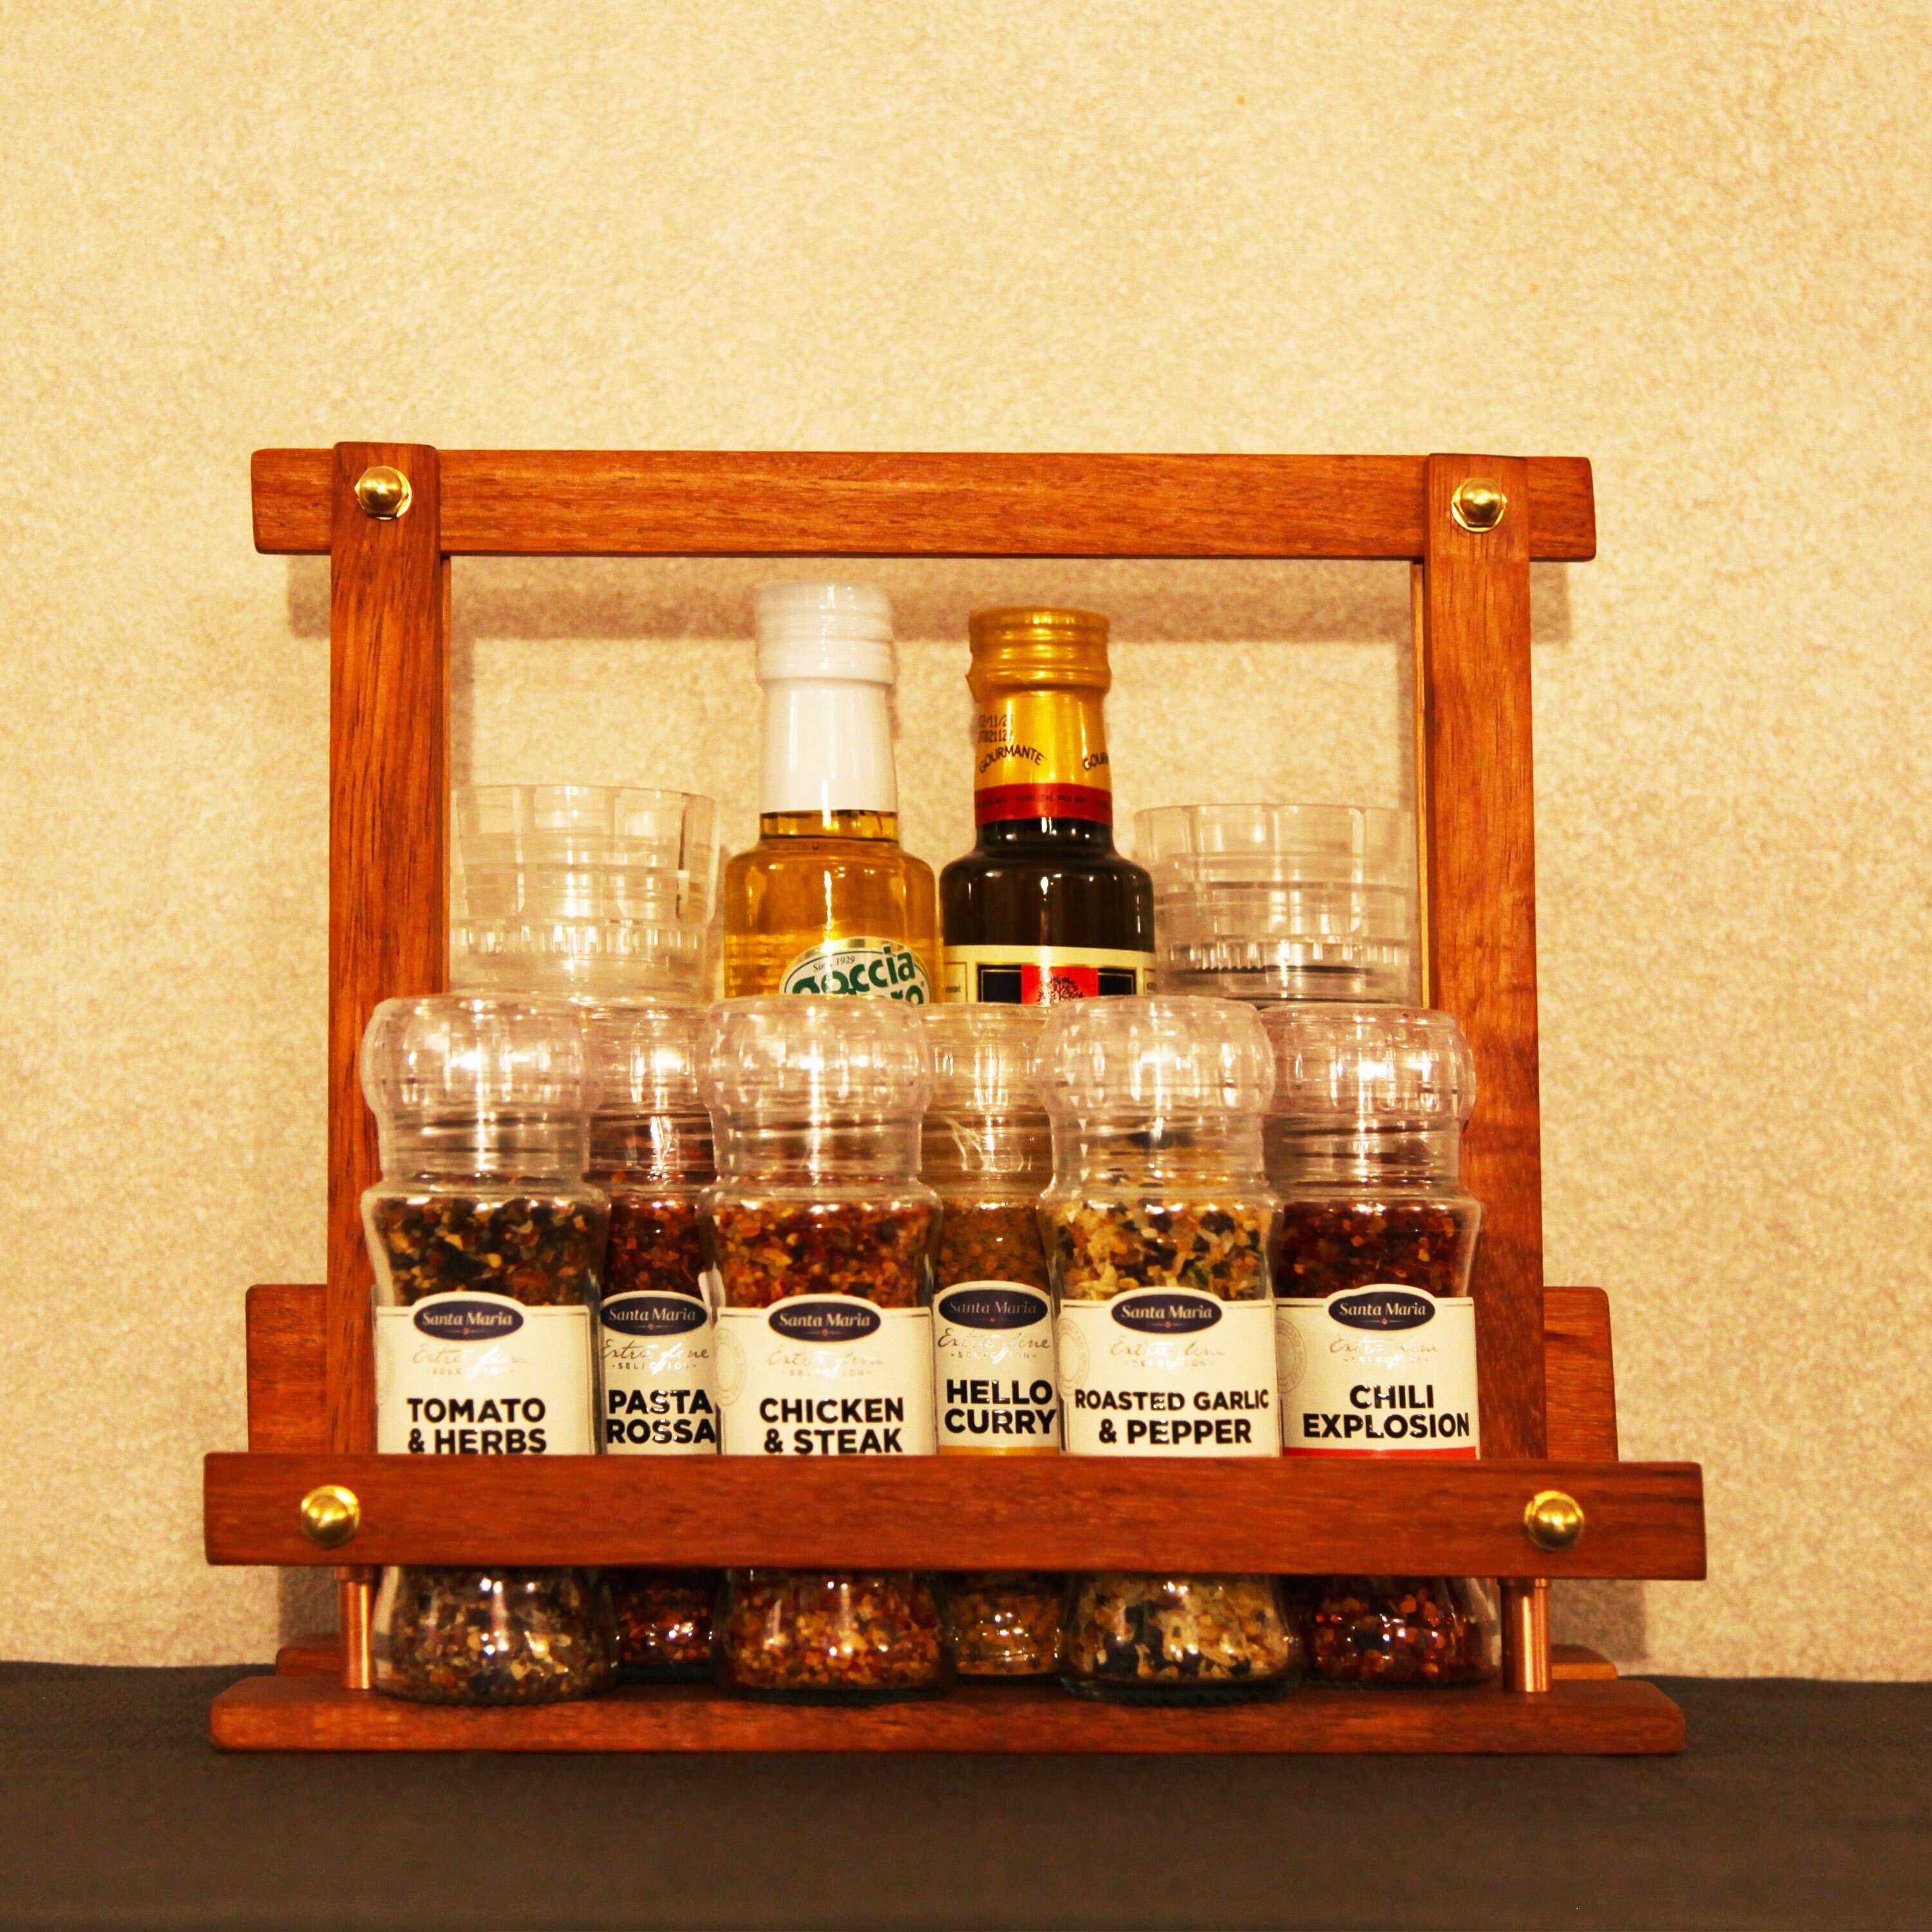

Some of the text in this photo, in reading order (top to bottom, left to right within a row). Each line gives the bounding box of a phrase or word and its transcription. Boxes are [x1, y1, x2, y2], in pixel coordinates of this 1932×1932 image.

[979, 744, 1044, 773] GOURMANTE
[837, 956, 855, 966] 1929
[422, 1311, 513, 1327] Santa Maria
[609, 1307, 696, 1321] Santa Maria
[779, 1312, 871, 1327] Santa Maria
[949, 1300, 1037, 1314] Santa Maria
[1121, 1304, 1212, 1319] Santa Maria
[1339, 1302, 1426, 1316] Santa Maria
[609, 1389, 713, 1414] PASTA
[947, 1379, 1053, 1405] HELLO
[1075, 1389, 1269, 1411] ROASTED GARLIC
[1350, 1385, 1434, 1409] CHILI
[407, 1397, 546, 1423] TOMATO
[759, 1397, 904, 1424] CHICKEN
[945, 1408, 1056, 1434] CURRY
[607, 1419, 716, 1444] ROSSA
[1099, 1418, 1252, 1445] & PEPPER
[1303, 1412, 1470, 1439] EXPLOSION
[408, 1428, 547, 1455] & HERBS
[764, 1428, 904, 1455] & STEAK
